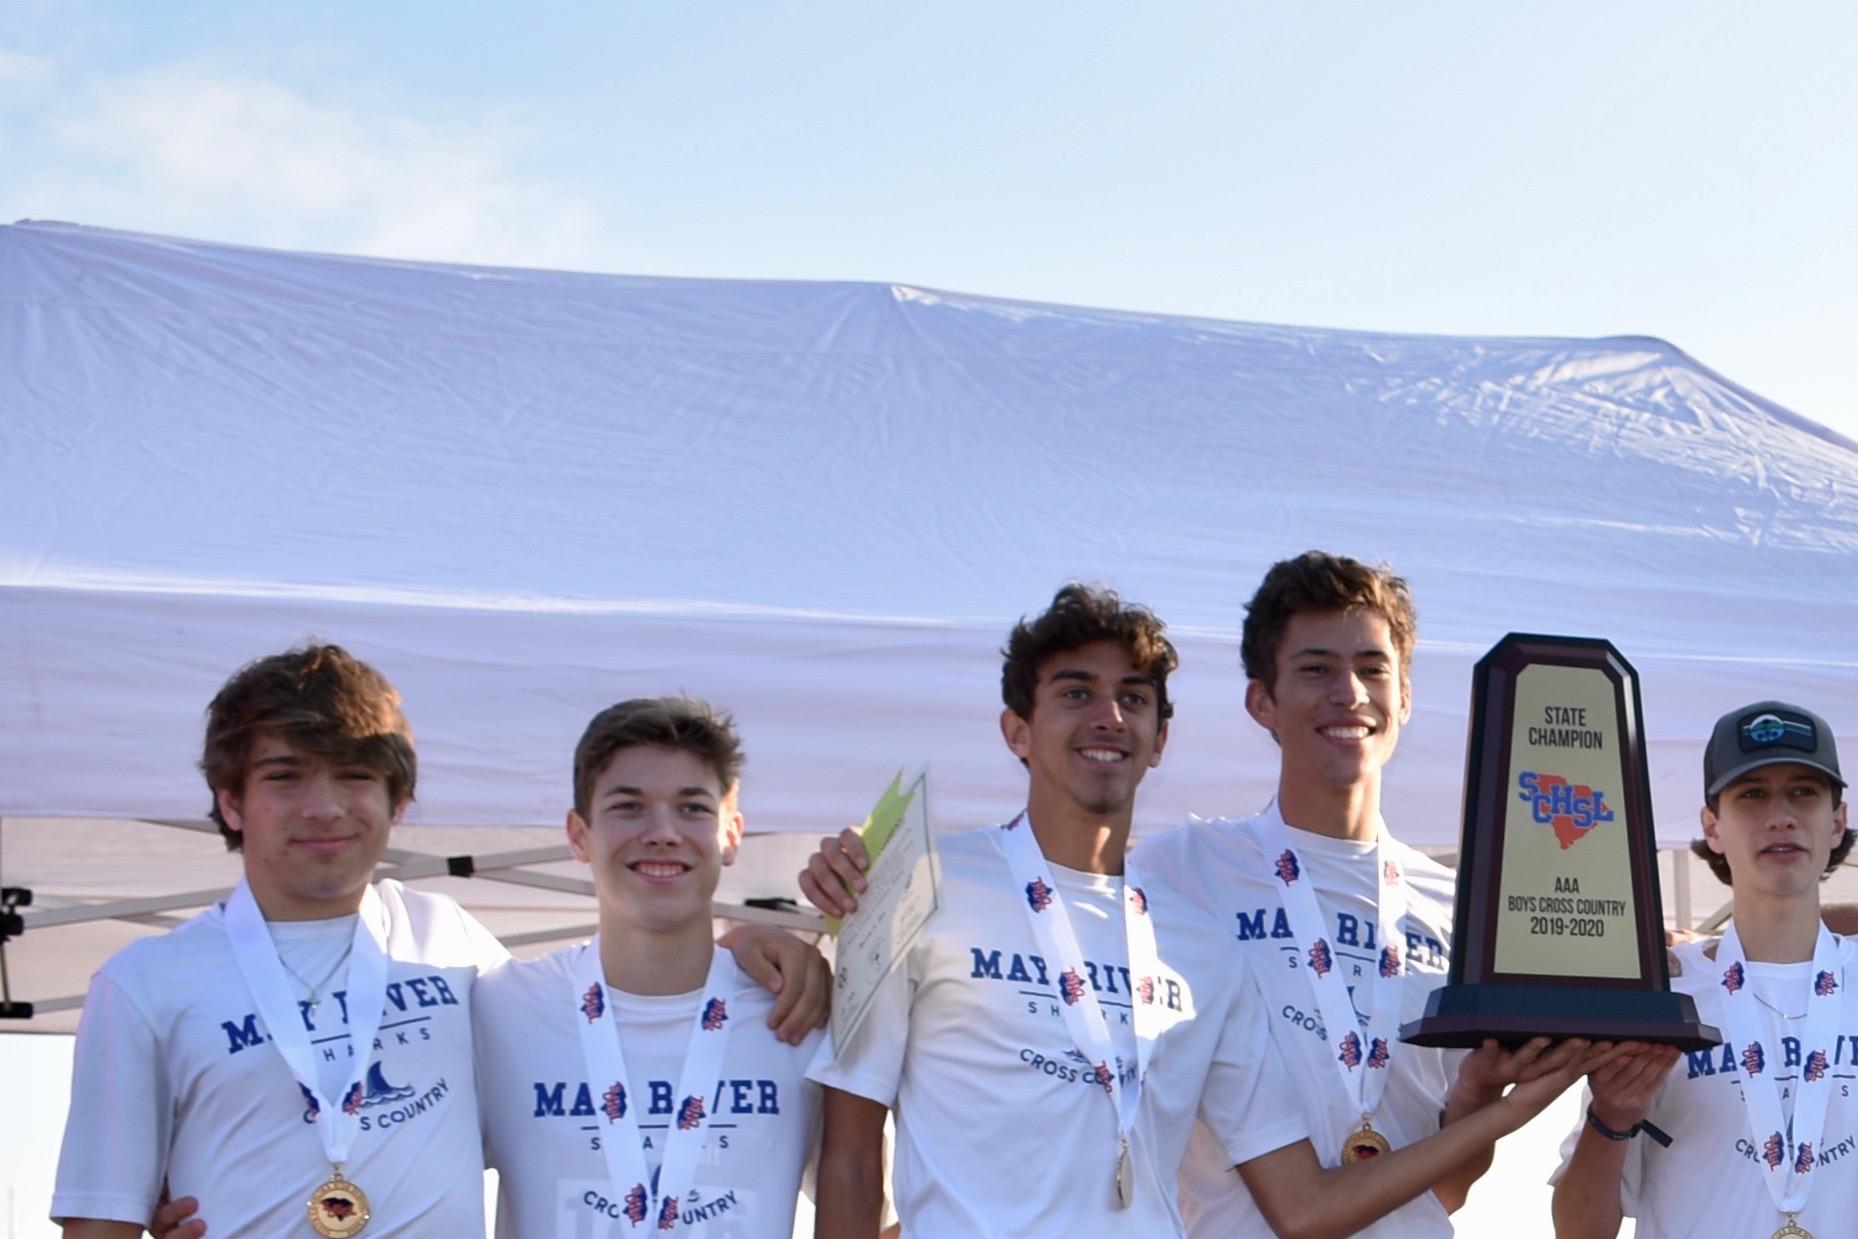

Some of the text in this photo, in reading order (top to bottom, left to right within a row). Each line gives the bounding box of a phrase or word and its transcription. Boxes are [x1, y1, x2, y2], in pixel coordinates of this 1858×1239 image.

[1544, 706, 1587, 727] STATE
[1528, 727, 1603, 749] CHAMPION
[1518, 771, 1614, 828] SCHSL
[1554, 877, 1580, 894] AAA
[1508, 895, 1626, 917] BOYS CROSS COUNTRY
[1236, 907, 1294, 940] MA
[1530, 916, 1604, 938] 2019-2020
[1020, 1048, 1078, 1083] CROSS
[1687, 1042, 1738, 1079] MA
[378, 1078, 450, 1129] COUNTRY
[533, 1082, 597, 1117] MA
